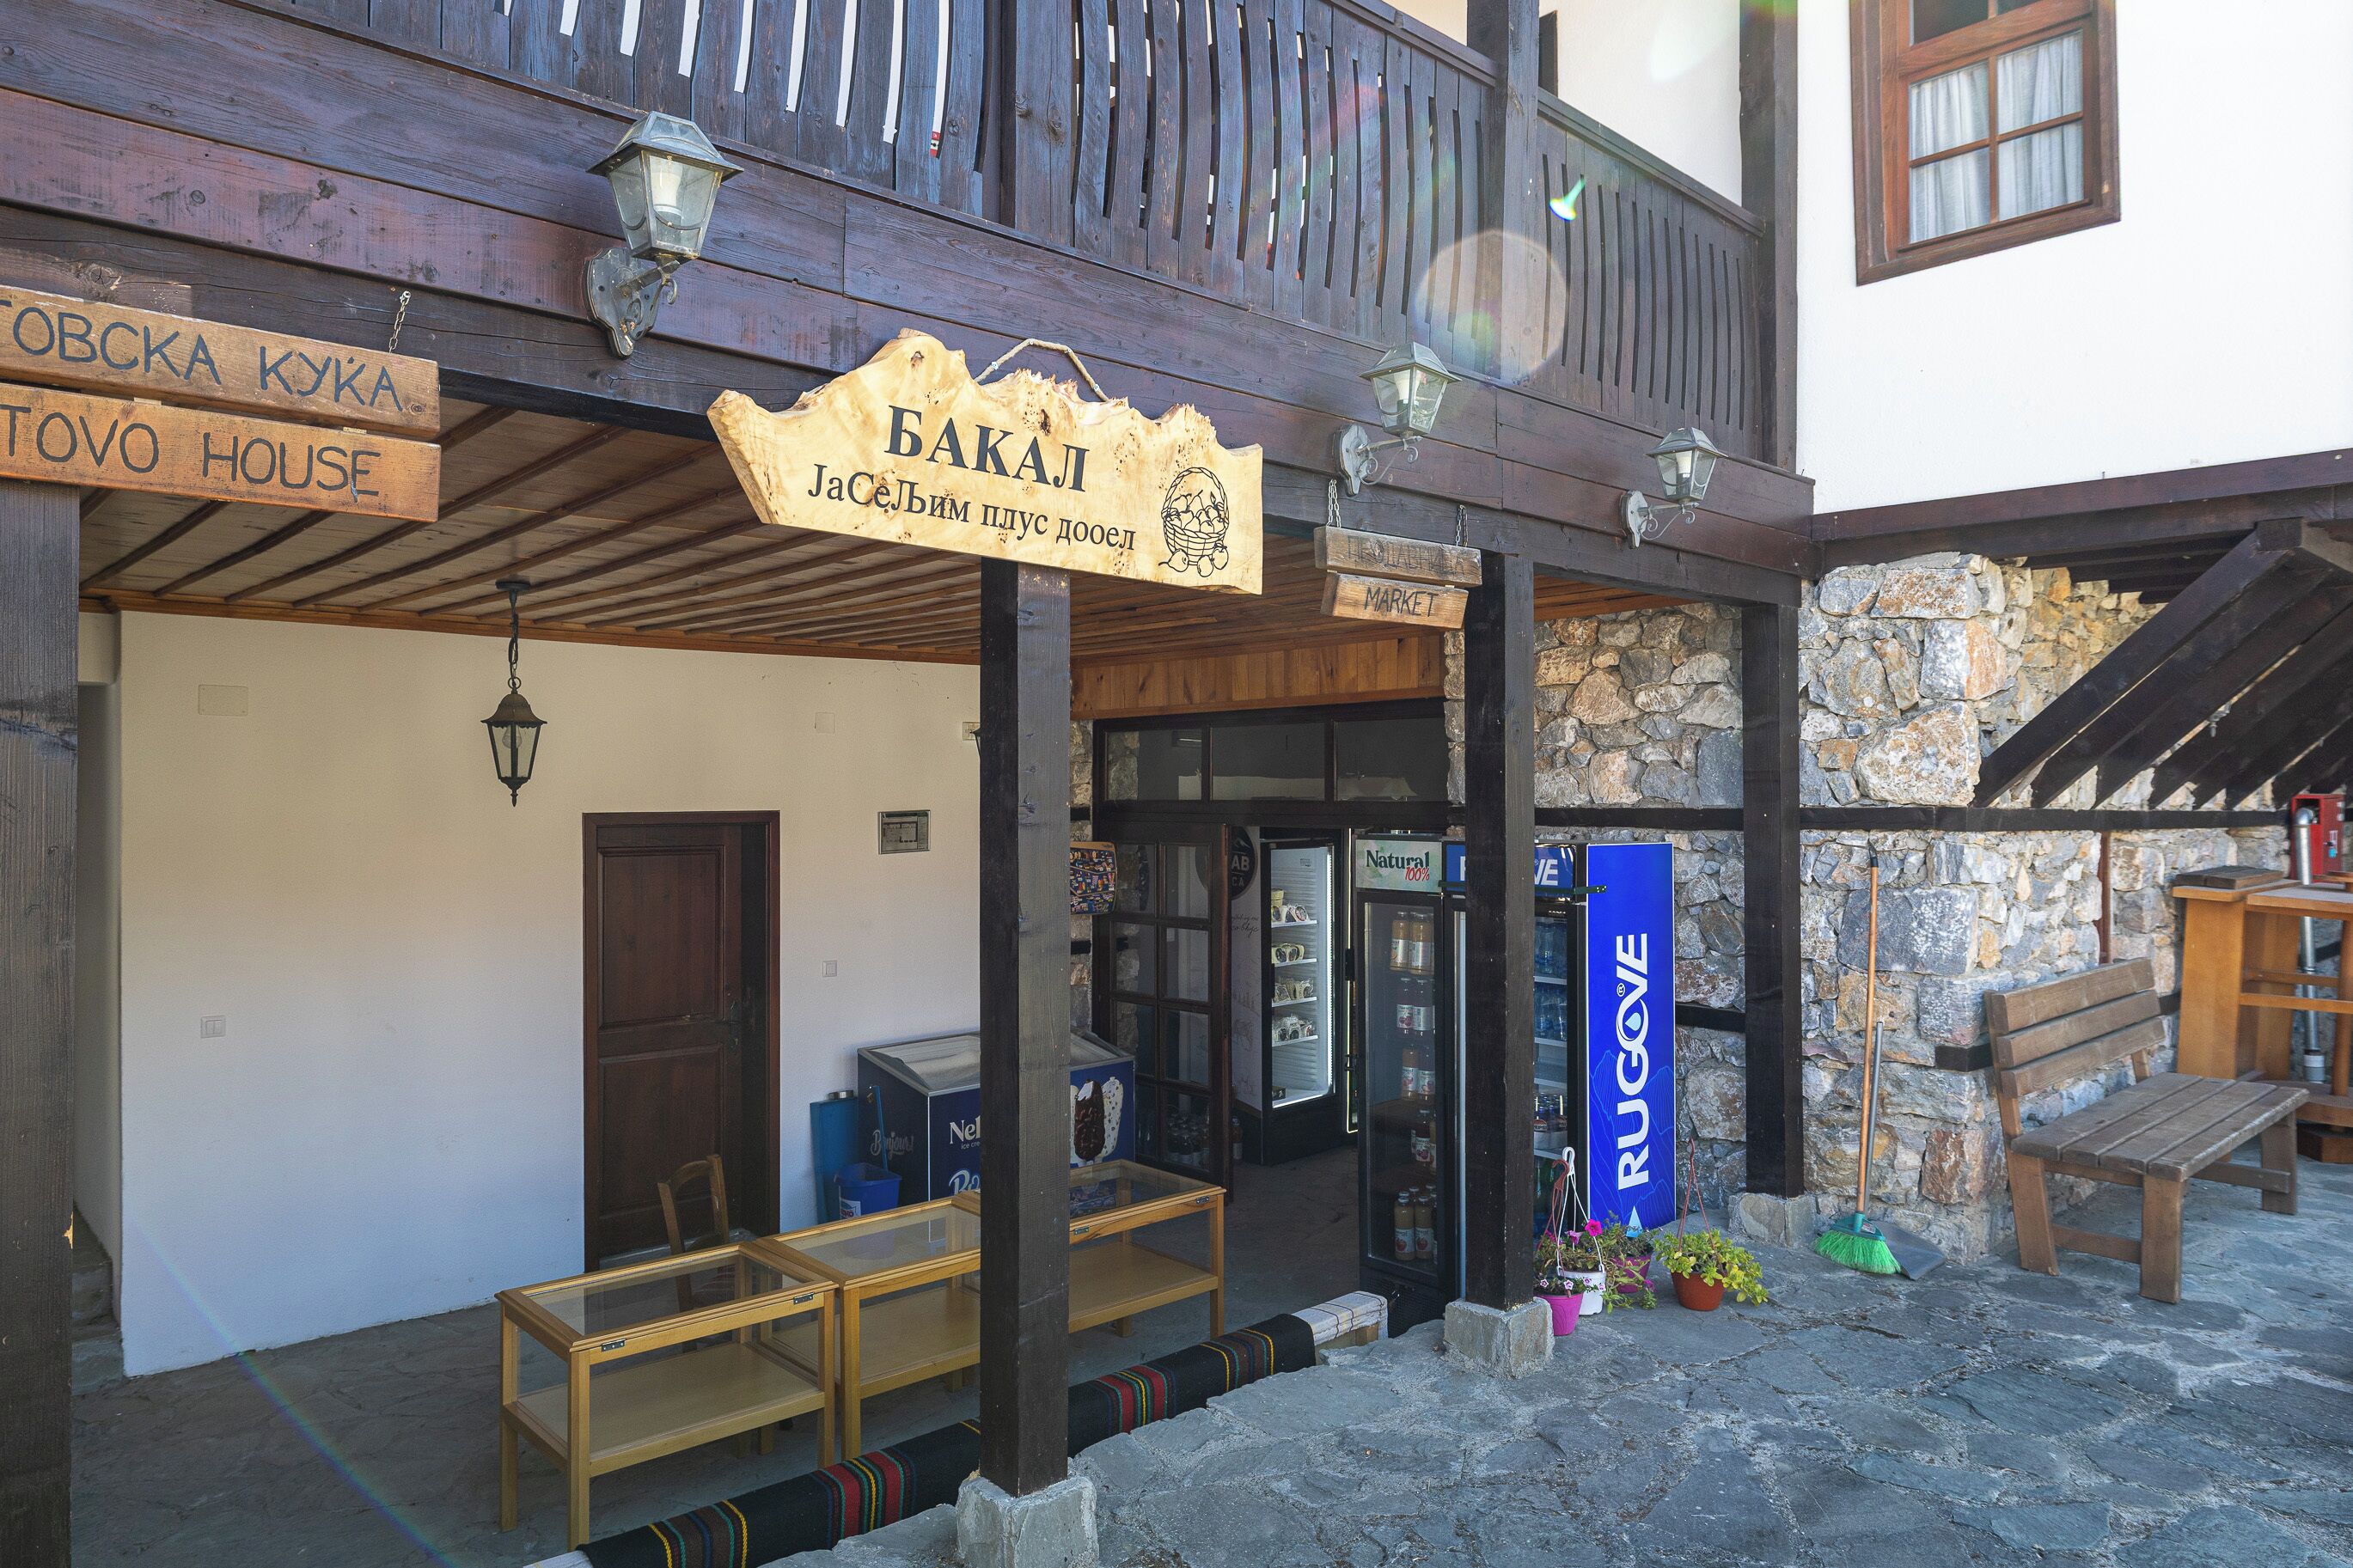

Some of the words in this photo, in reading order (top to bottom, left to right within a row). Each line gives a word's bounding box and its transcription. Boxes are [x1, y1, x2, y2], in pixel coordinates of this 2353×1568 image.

[202, 431, 382, 503] HOUSE
[884, 405, 1090, 492] БАКАЛ
[981, 503, 1049, 542] плус
[1055, 516, 1137, 551] дооел
[1364, 587, 1439, 618] MARKET
[1366, 849, 1430, 869] Natural
[1404, 865, 1430, 882] 100%
